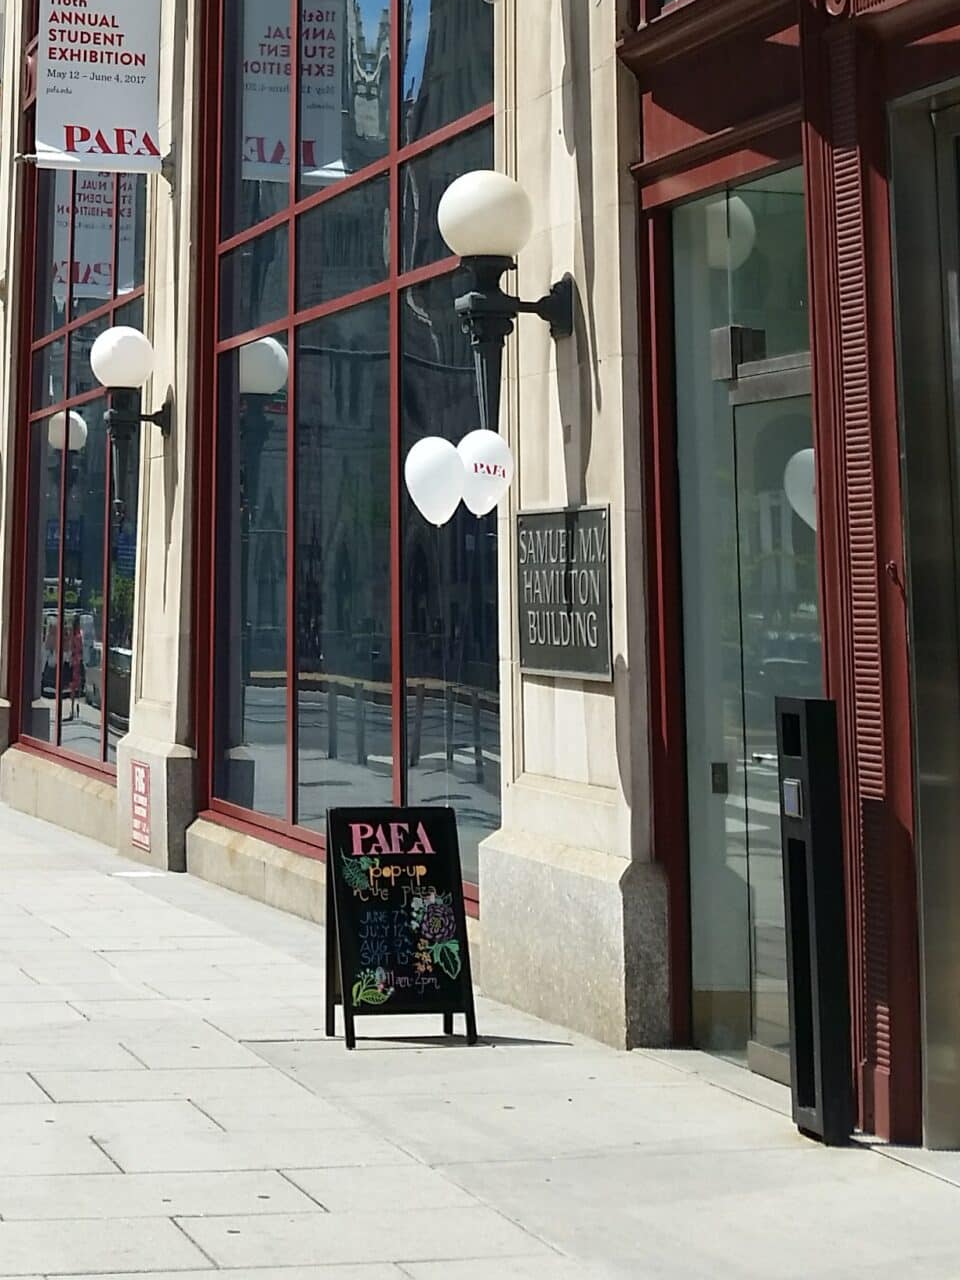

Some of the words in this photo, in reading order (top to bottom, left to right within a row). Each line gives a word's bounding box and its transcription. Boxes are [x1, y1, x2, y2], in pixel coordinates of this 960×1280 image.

[48, 10, 119, 28] ANNUAL
[48, 28, 124, 47] STUDENT
[48, 47, 146, 67] EXHIBITION
[47, 68, 67, 80] May
[70, 71, 79, 79] 12
[89, 72, 112, 81] June
[124, 75, 146, 84] 2017
[63, 125, 161, 156] PAFA
[474, 463, 506, 479] PAFA
[519, 528, 576, 564] SAMUEL
[523, 570, 600, 605] HAMILTON
[528, 611, 597, 647] BUILDING
[348, 821, 437, 855] PAFA
